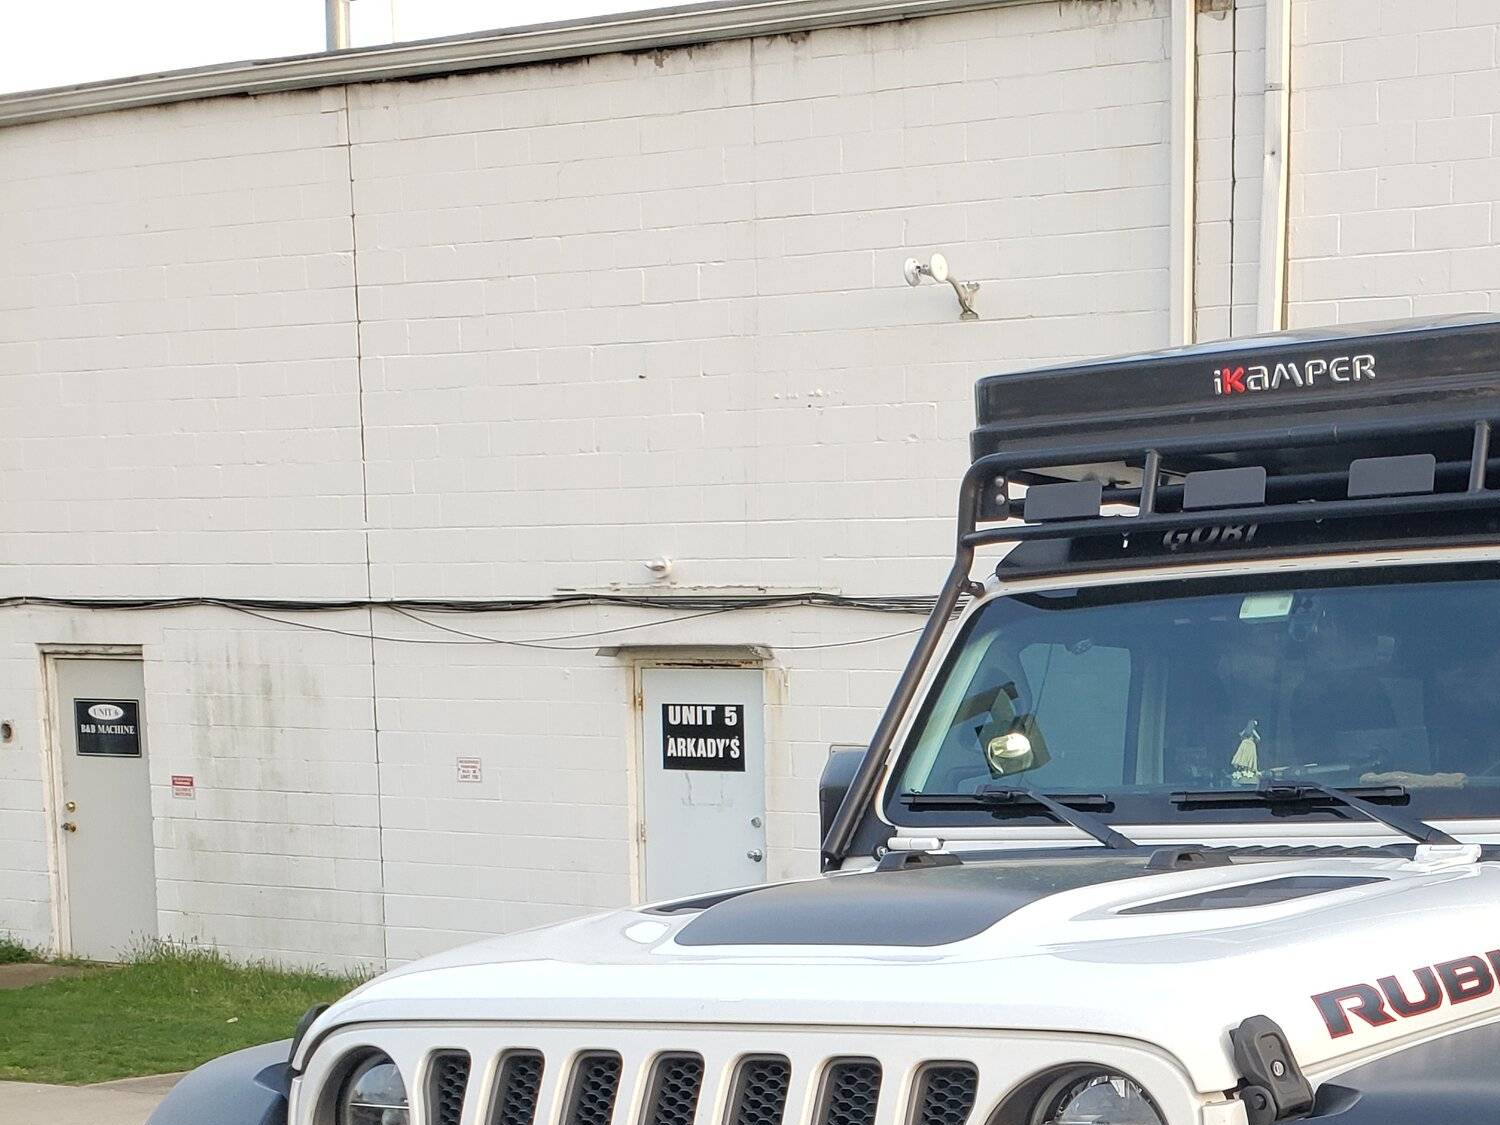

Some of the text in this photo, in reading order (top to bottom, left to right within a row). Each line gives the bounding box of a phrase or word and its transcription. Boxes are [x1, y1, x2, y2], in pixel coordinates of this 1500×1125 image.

[668, 705, 738, 726] UNIT 5
[80, 724, 136, 734] B&B MACHINE
[667, 736, 740, 758] ARKADY'S
